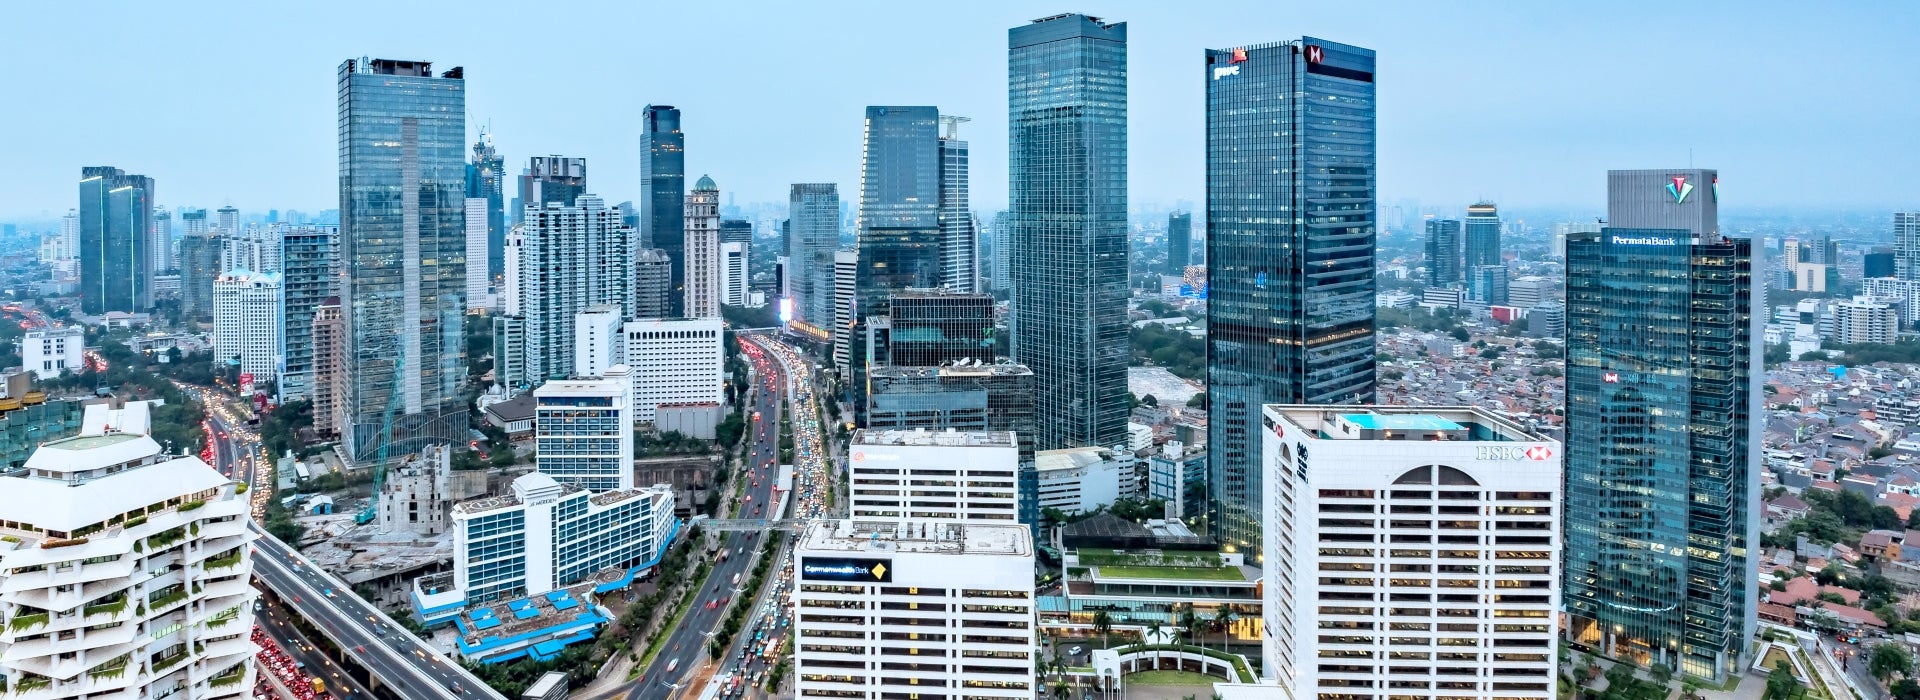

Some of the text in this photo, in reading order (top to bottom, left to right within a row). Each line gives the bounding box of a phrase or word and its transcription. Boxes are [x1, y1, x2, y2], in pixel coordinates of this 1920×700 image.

[1214, 66, 1240, 80] pwc
[1612, 235, 1675, 246] PermataBank
[1476, 446, 1525, 461] HSBC
[804, 565, 869, 575] Commonwealth Bank
